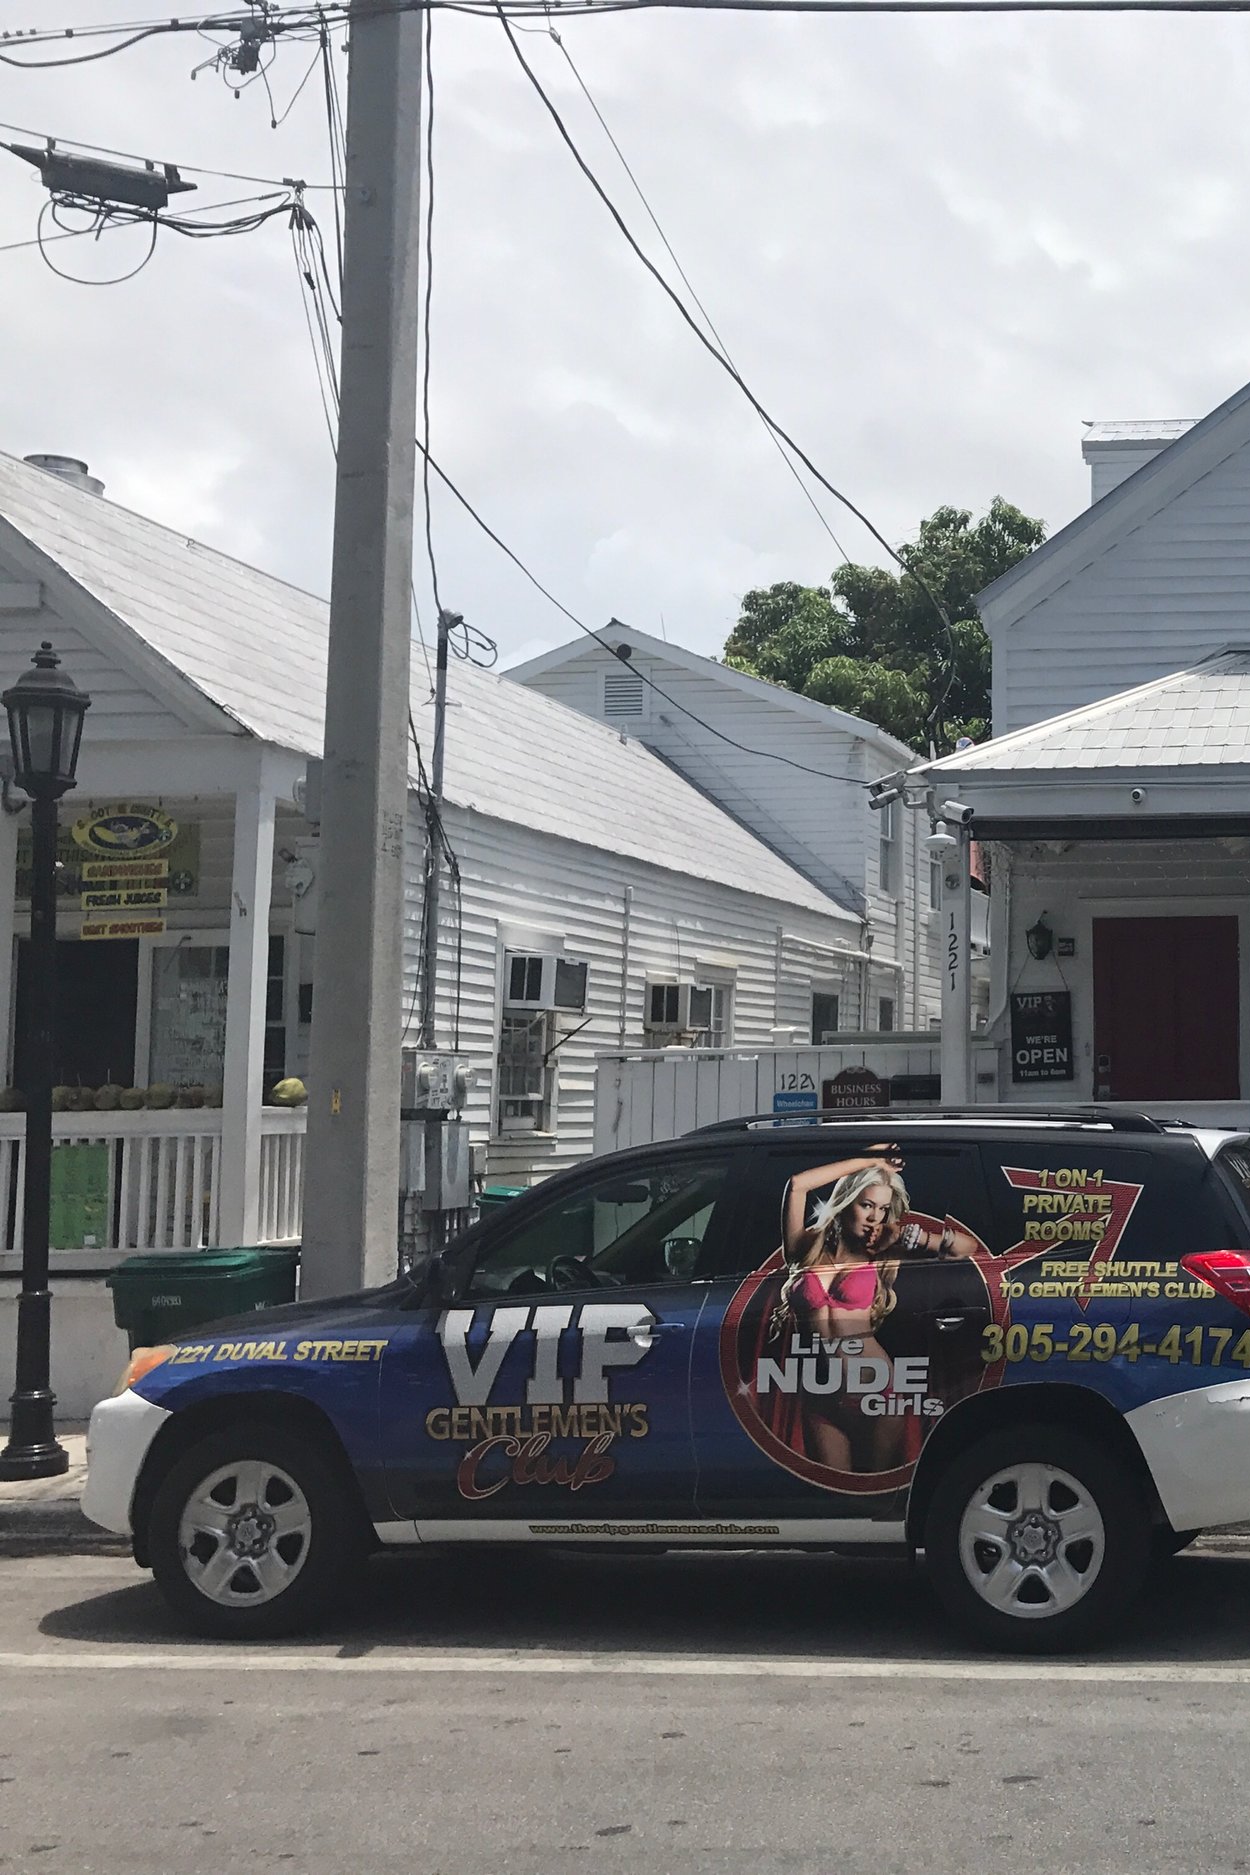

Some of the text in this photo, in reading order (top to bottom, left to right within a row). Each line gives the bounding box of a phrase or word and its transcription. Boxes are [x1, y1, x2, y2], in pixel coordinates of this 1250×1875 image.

[948, 911, 959, 992] 1221
[1017, 996, 1042, 1009] VIP
[1025, 1034, 1057, 1045] WE'RE
[1016, 1047, 1068, 1065] OPEN
[780, 1073, 816, 1091] 1221
[830, 1083, 882, 1095] BUSINESS
[836, 1096, 877, 1108] HOURS
[1038, 1168, 1049, 1188] 1
[1054, 1168, 1088, 1188] ON
[1022, 1194, 1113, 1215] PRIVATE
[1023, 1220, 1107, 1242] ROOMS
[1040, 1260, 1179, 1278] FREE SHUTTLE
[998, 1281, 1217, 1300] TO GENTLEMEN'S CLUB
[168, 1339, 389, 1366] 1221 DUVAL STREET
[790, 1332, 865, 1356] Live
[434, 1303, 658, 1409] VIP
[756, 1356, 931, 1395] NUDE
[860, 1393, 946, 1417] Girls
[425, 1404, 649, 1441] GENTLEMEN'S
[456, 1430, 616, 1501] Club
[528, 1523, 781, 1536] www.thevipgentlemensclub.com
